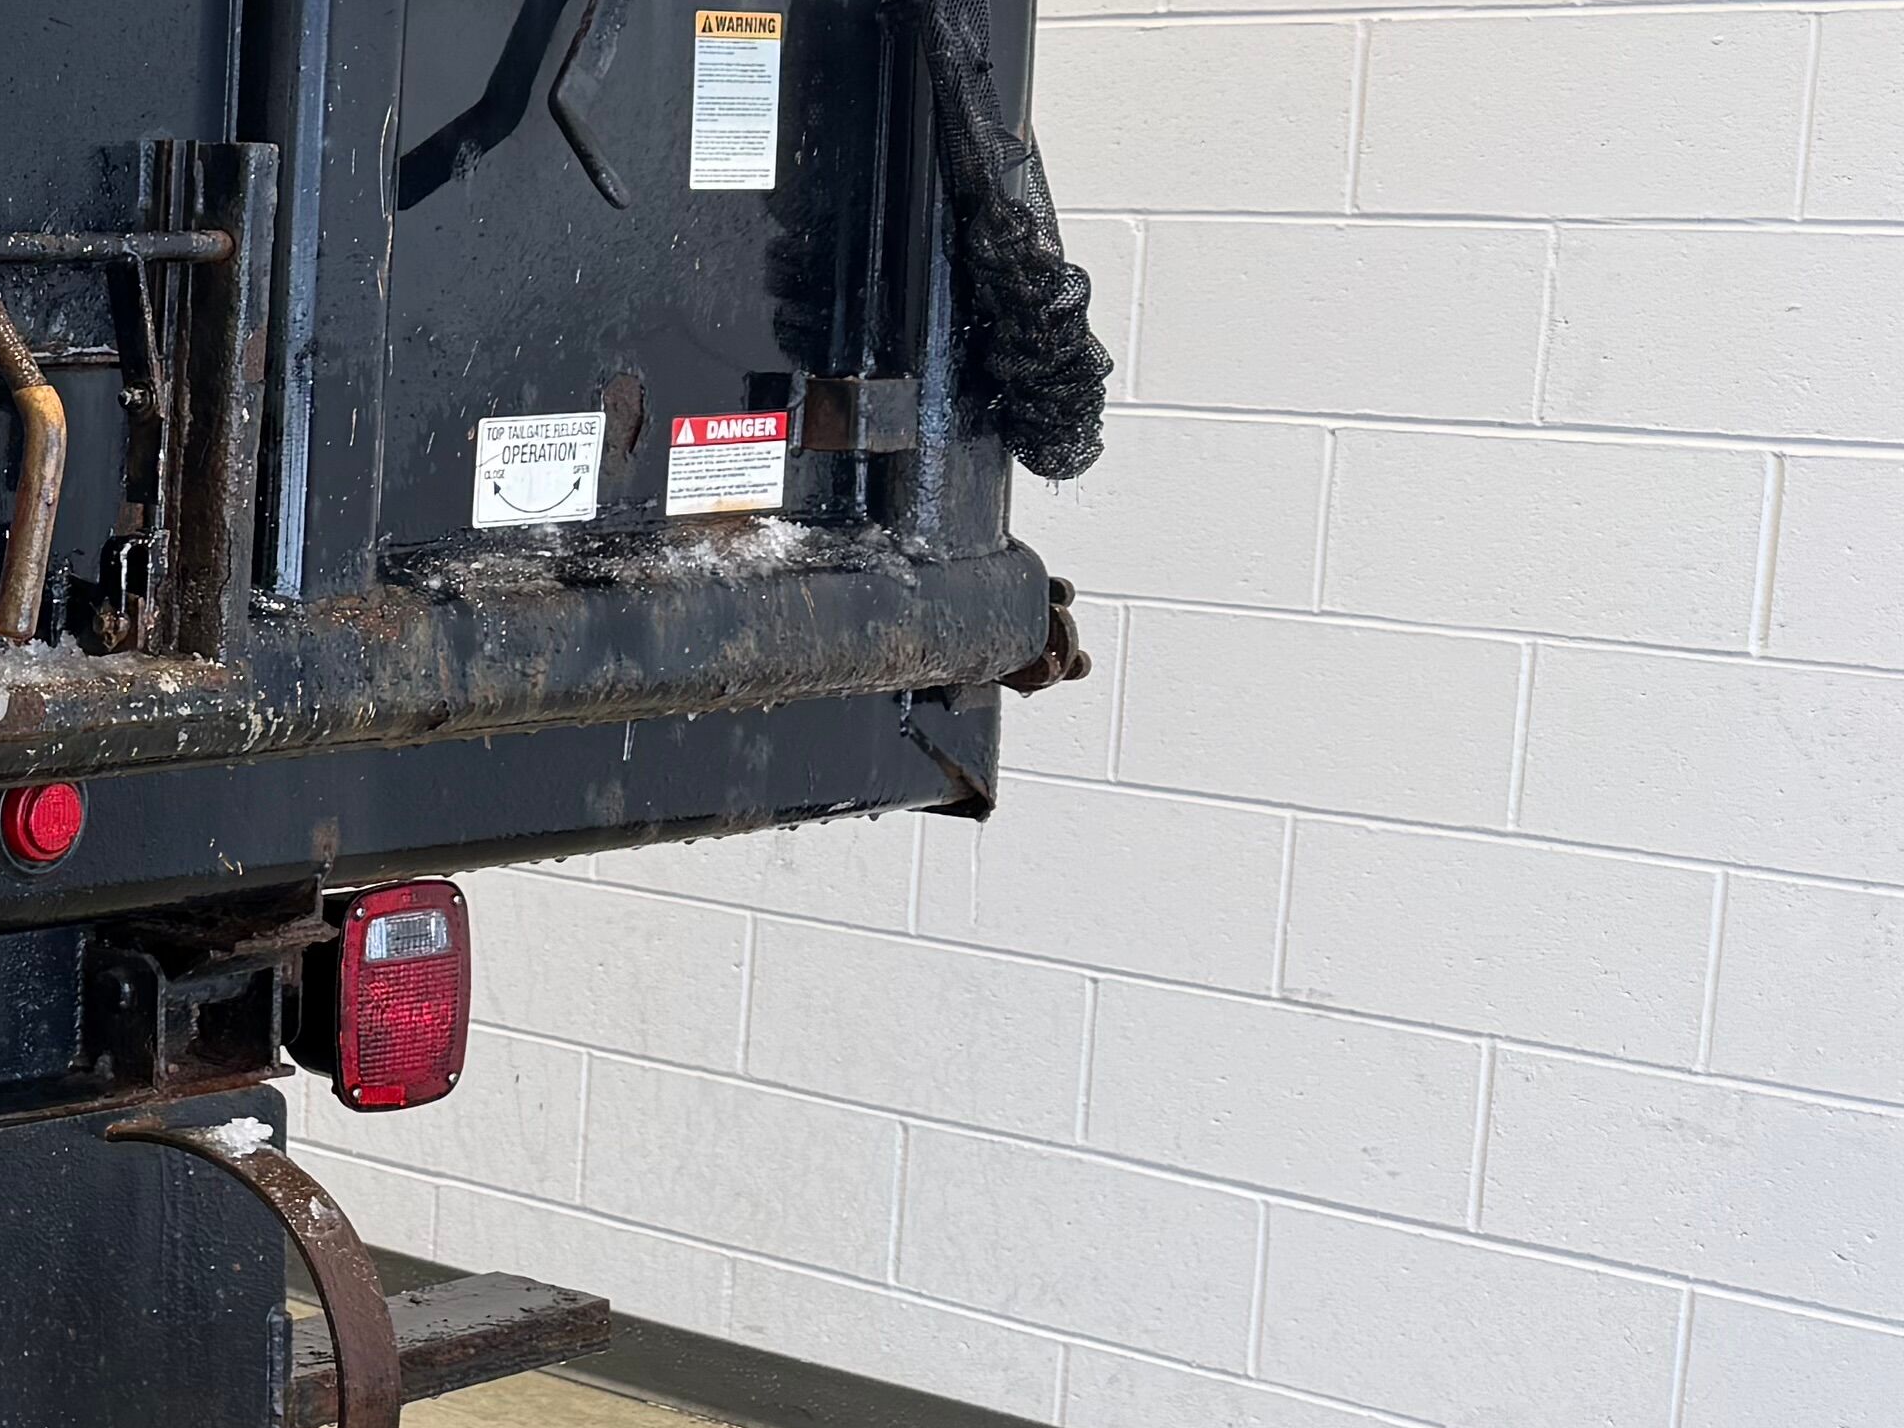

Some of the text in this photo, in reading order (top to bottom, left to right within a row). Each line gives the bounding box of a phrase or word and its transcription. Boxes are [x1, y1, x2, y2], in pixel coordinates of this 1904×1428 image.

[715, 15, 776, 34] WARNING
[487, 421, 597, 441] TOP TAILGATE RELEASE
[705, 417, 777, 440] DANGER
[502, 441, 577, 465] OPERATION
